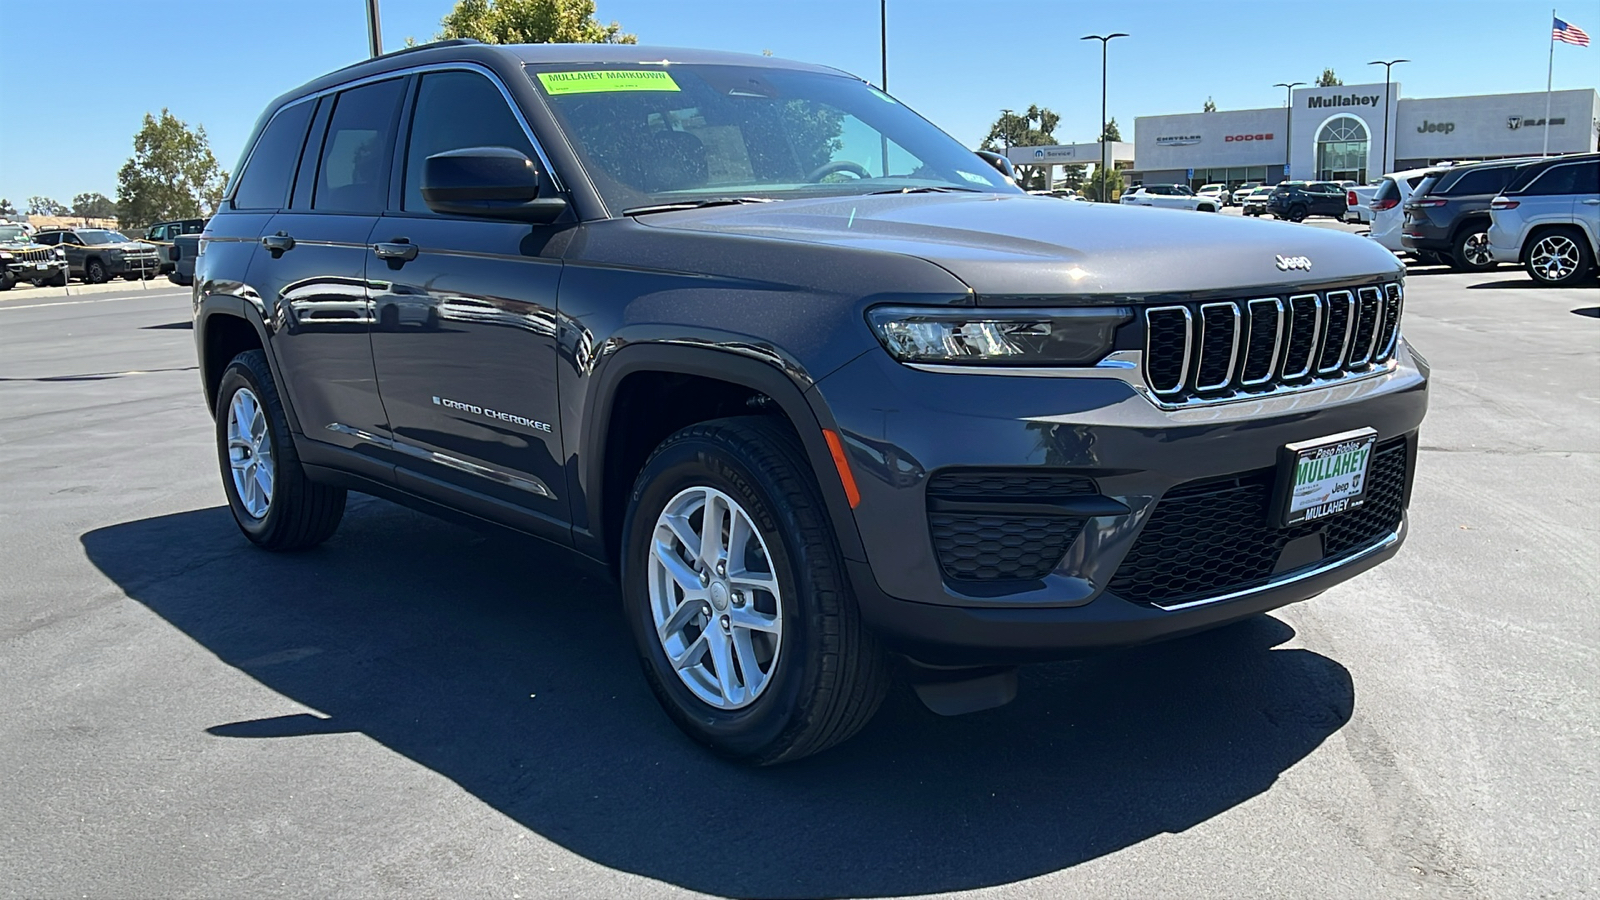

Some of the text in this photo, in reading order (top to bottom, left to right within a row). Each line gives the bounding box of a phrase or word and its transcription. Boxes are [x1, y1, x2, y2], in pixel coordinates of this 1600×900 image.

[549, 72, 666, 82] MULLAHEY MARKDOWN
[1308, 94, 1380, 109] Mullahey
[1417, 120, 1455, 135] Jeep
[1524, 118, 1566, 126] RAM
[1225, 133, 1274, 143] DODGE
[1276, 254, 1312, 271] Jeep
[442, 398, 552, 433] GRAND CHEROKEE
[1297, 449, 1369, 486] MULLAHEY
[1332, 482, 1349, 494] Jeep
[1305, 498, 1349, 521] MULLAHEY
